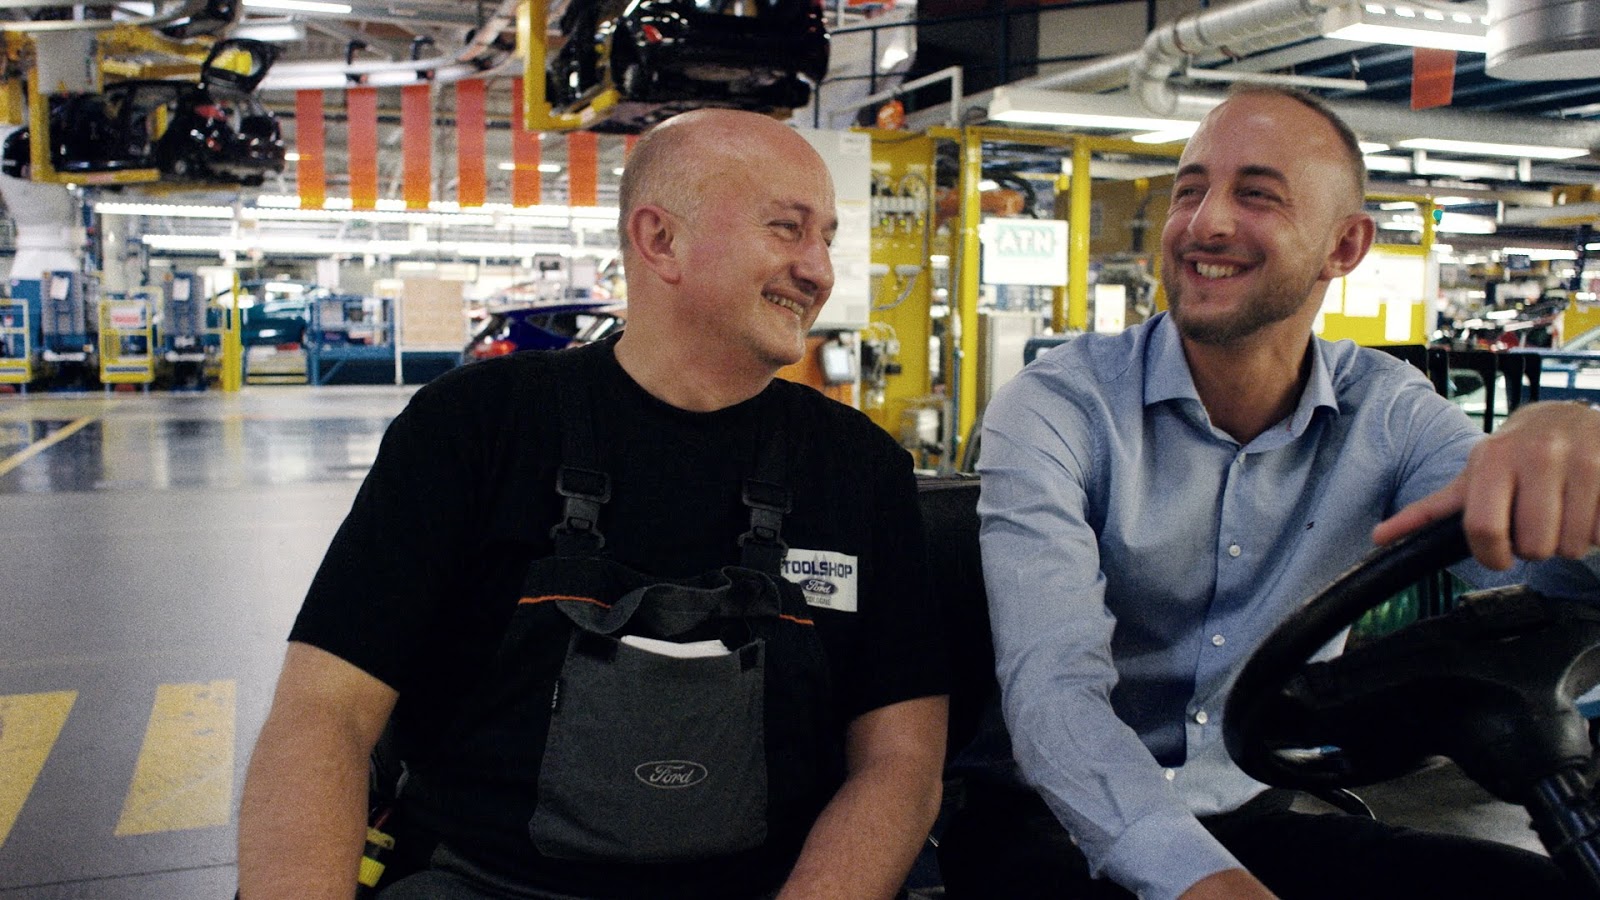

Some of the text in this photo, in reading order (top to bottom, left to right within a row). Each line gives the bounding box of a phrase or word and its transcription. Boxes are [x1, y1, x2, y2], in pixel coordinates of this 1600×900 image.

[999, 229, 1052, 253] ATN
[783, 560, 852, 578] TOOLSHOP
[806, 579, 831, 593] Ford
[649, 765, 694, 783] Ford
